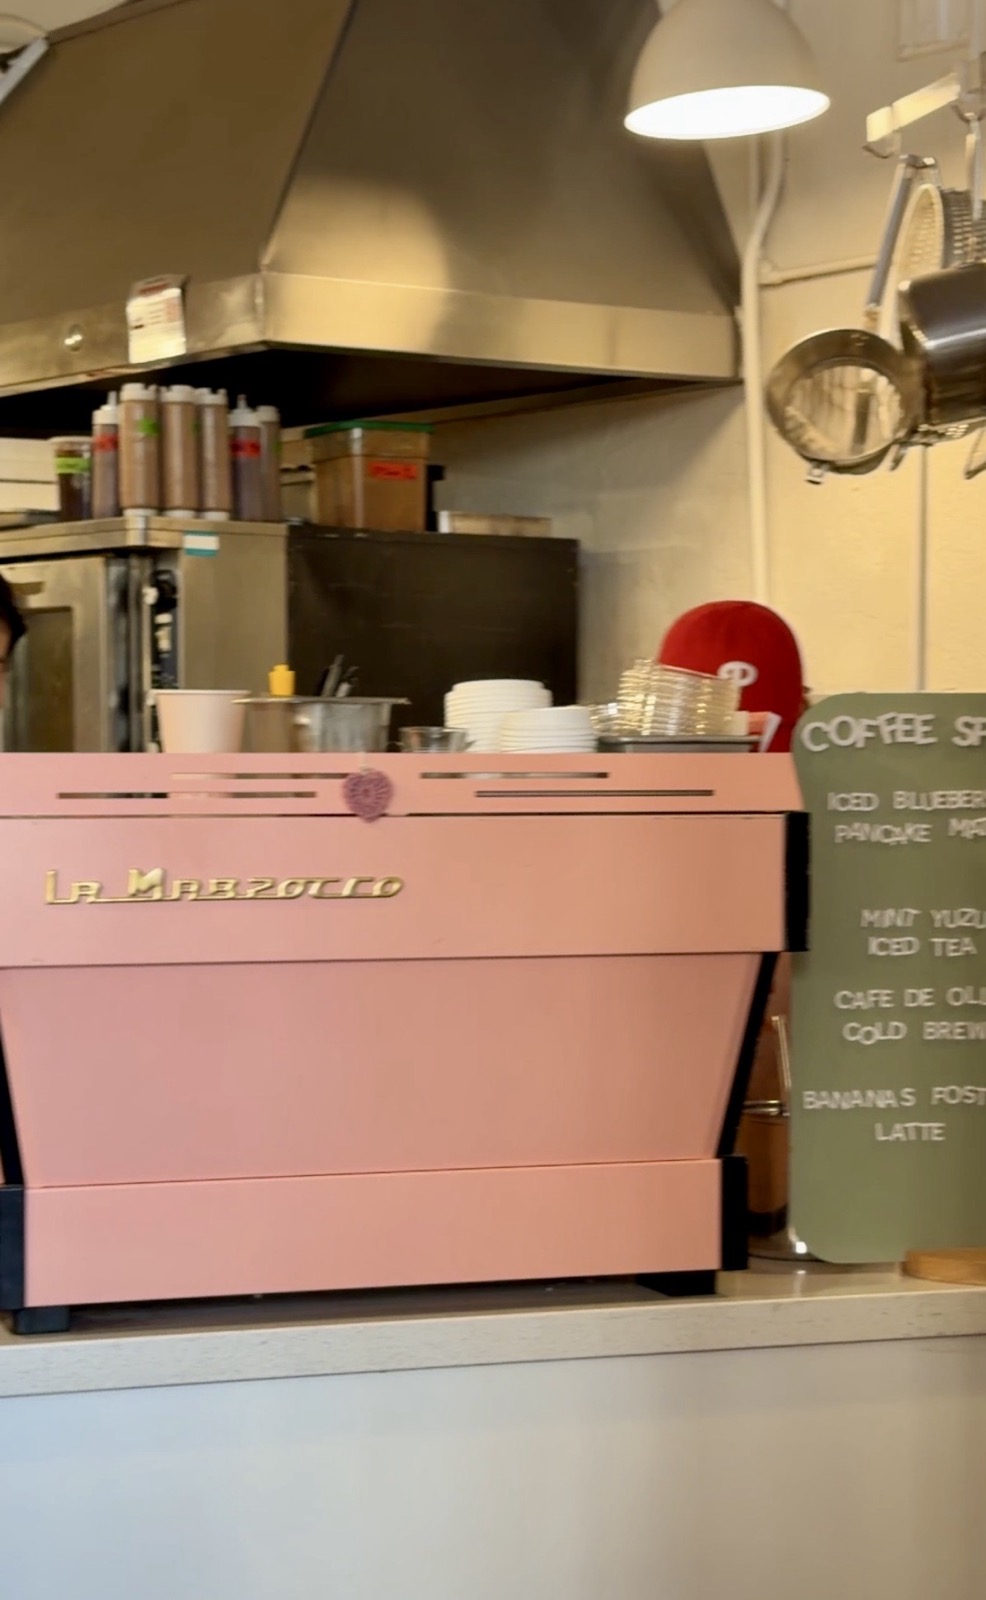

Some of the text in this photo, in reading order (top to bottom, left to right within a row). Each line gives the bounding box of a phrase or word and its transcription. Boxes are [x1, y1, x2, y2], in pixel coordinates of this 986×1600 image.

[801, 711, 938, 752] COFFEE
[827, 792, 879, 811] ICED
[834, 821, 933, 846] PANCAKE
[860, 908, 922, 928] MINT
[867, 936, 978, 957] ICED TEA
[833, 989, 895, 1009] CAFE
[904, 988, 936, 1007] DE
[842, 1021, 908, 1045] COLD
[803, 1088, 917, 1110] BANANAS
[874, 1122, 946, 1141] LATTE
